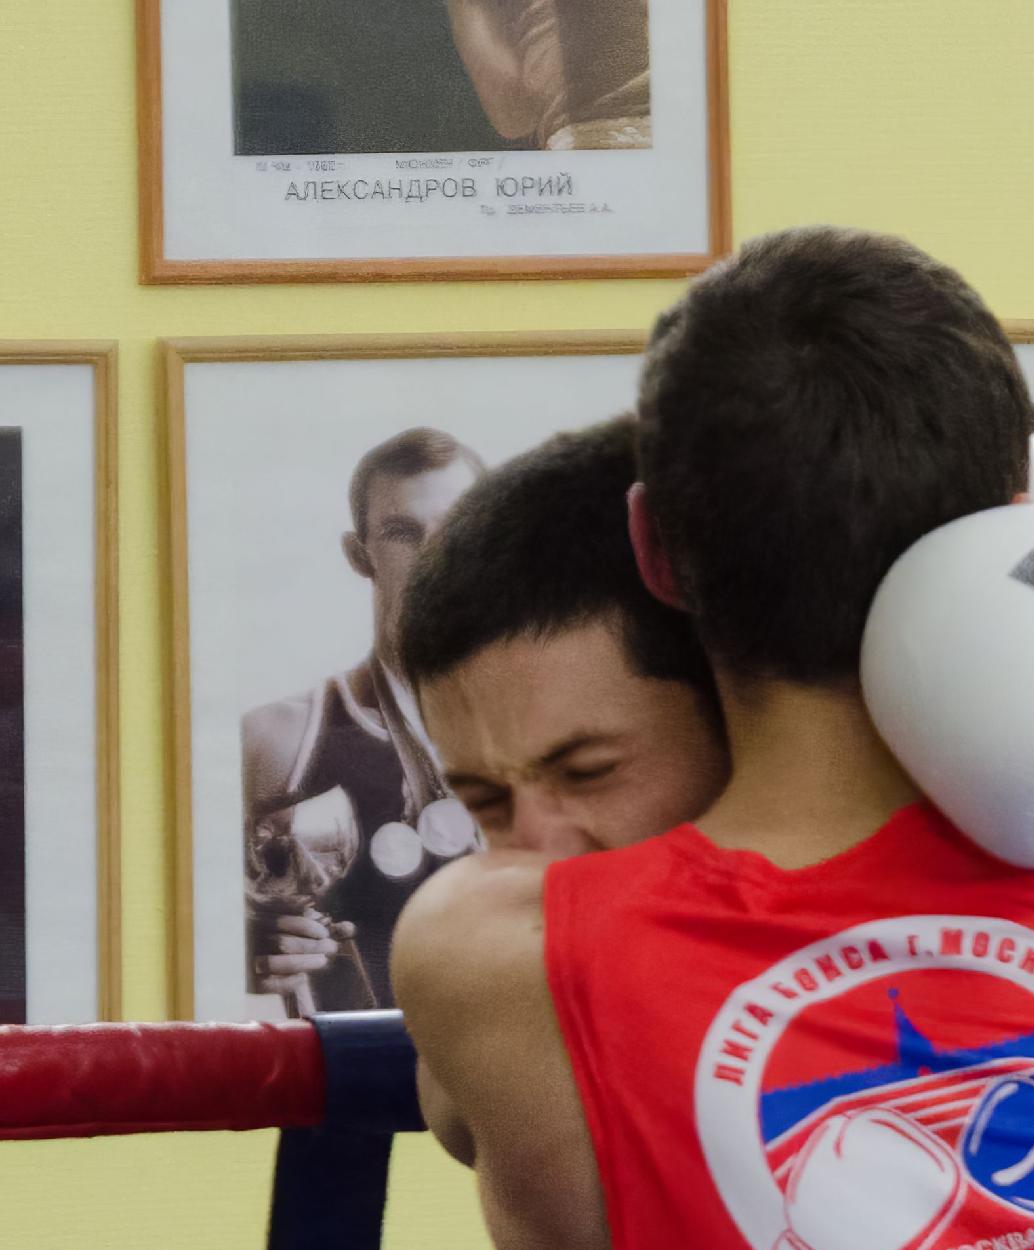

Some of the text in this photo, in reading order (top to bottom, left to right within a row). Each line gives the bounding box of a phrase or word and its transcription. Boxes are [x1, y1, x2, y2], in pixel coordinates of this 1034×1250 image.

[284, 172, 575, 203] АЛЕКСАНДРОВ ЮРИЙ
[714, 1000, 774, 1087] ЛИГА
[773, 938, 890, 1000] БОКСА
